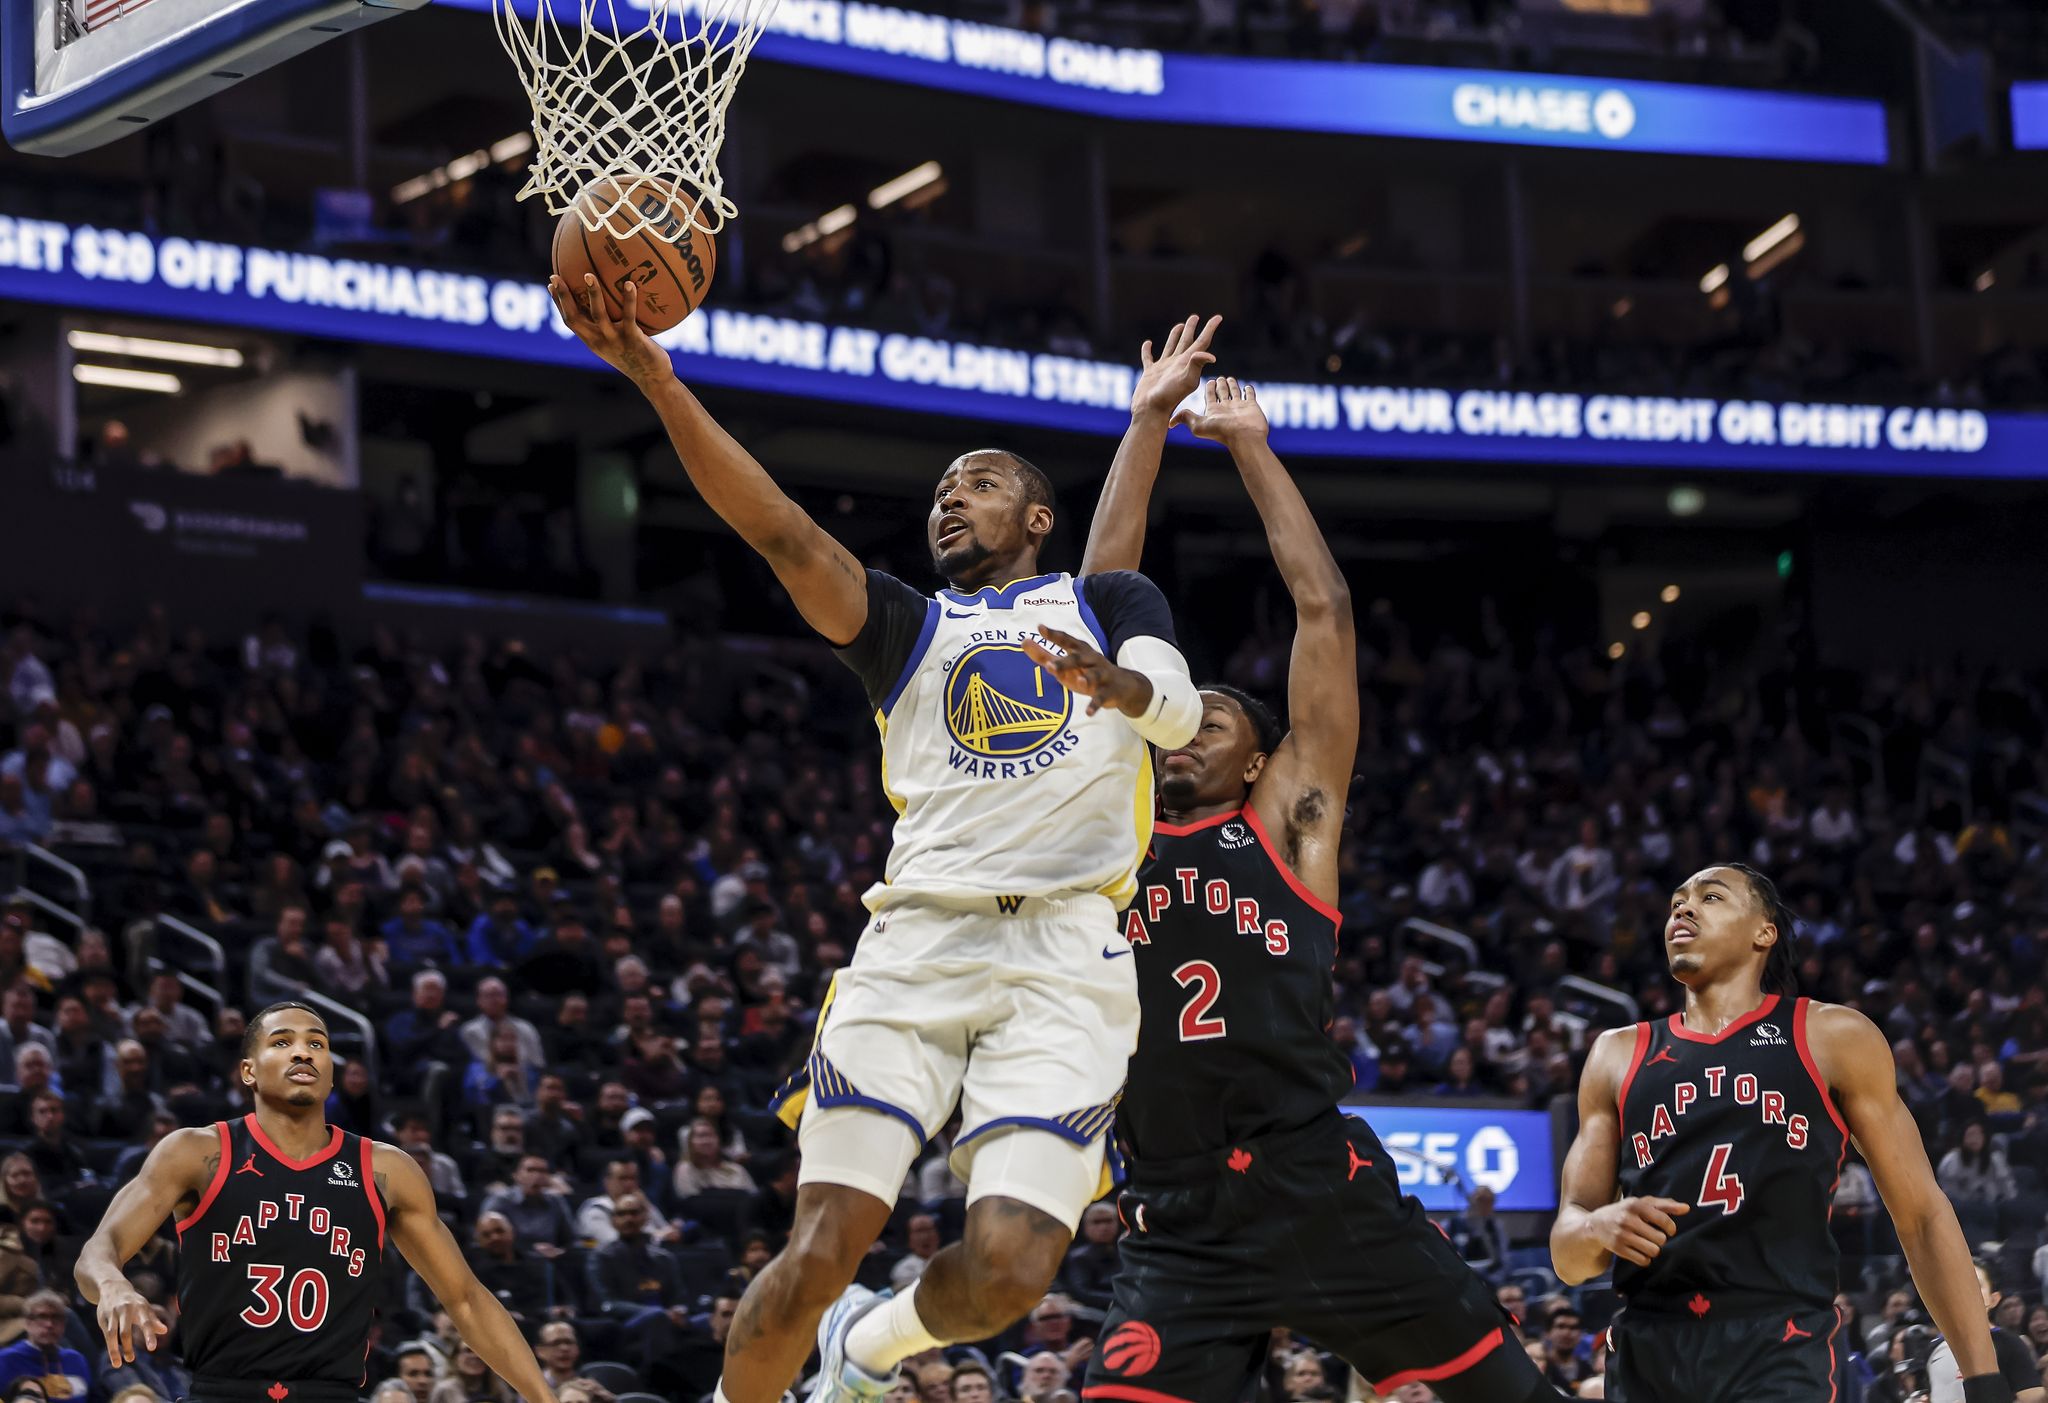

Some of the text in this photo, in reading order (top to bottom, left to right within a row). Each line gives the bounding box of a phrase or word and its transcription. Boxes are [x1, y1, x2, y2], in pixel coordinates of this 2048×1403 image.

[846, 4, 949, 61] MORE
[952, 22, 1044, 77] WITH
[1047, 39, 1164, 95] CHASE
[1454, 84, 1590, 133] CHASE
[0, 217, 69, 272] GET
[74, 228, 155, 283] $20
[159, 239, 242, 293] OFF
[247, 250, 488, 325] PURCHASES
[491, 281, 549, 333] OF
[711, 311, 826, 369] MORE
[828, 328, 879, 375] AT
[880, 335, 1030, 396] GOLDEN
[1032, 356, 1135, 411] STATE
[1341, 388, 1453, 432] YOUR
[1457, 392, 1581, 437] CHASE
[1585, 397, 1715, 441] CREDIT
[1719, 402, 1776, 443] OR
[1780, 404, 1882, 447] DEBIT
[1887, 409, 1987, 451] CARD
[1023, 597, 1075, 606] Rakuten
[942, 629, 1008, 673] GDEN
[948, 728, 1080, 780] WARRIORS
[1217, 835, 1256, 850] Sun Life
[1124, 867, 1290, 956] APTORS
[1171, 959, 1227, 1042] 2
[1749, 1036, 1788, 1047] Sun Life
[1631, 1065, 1809, 1169] RAPTORS
[327, 1176, 359, 1188] Sun Life
[1696, 1142, 1745, 1216] 4
[211, 1192, 366, 1278] RAPTORS
[239, 1263, 330, 1333] 30
